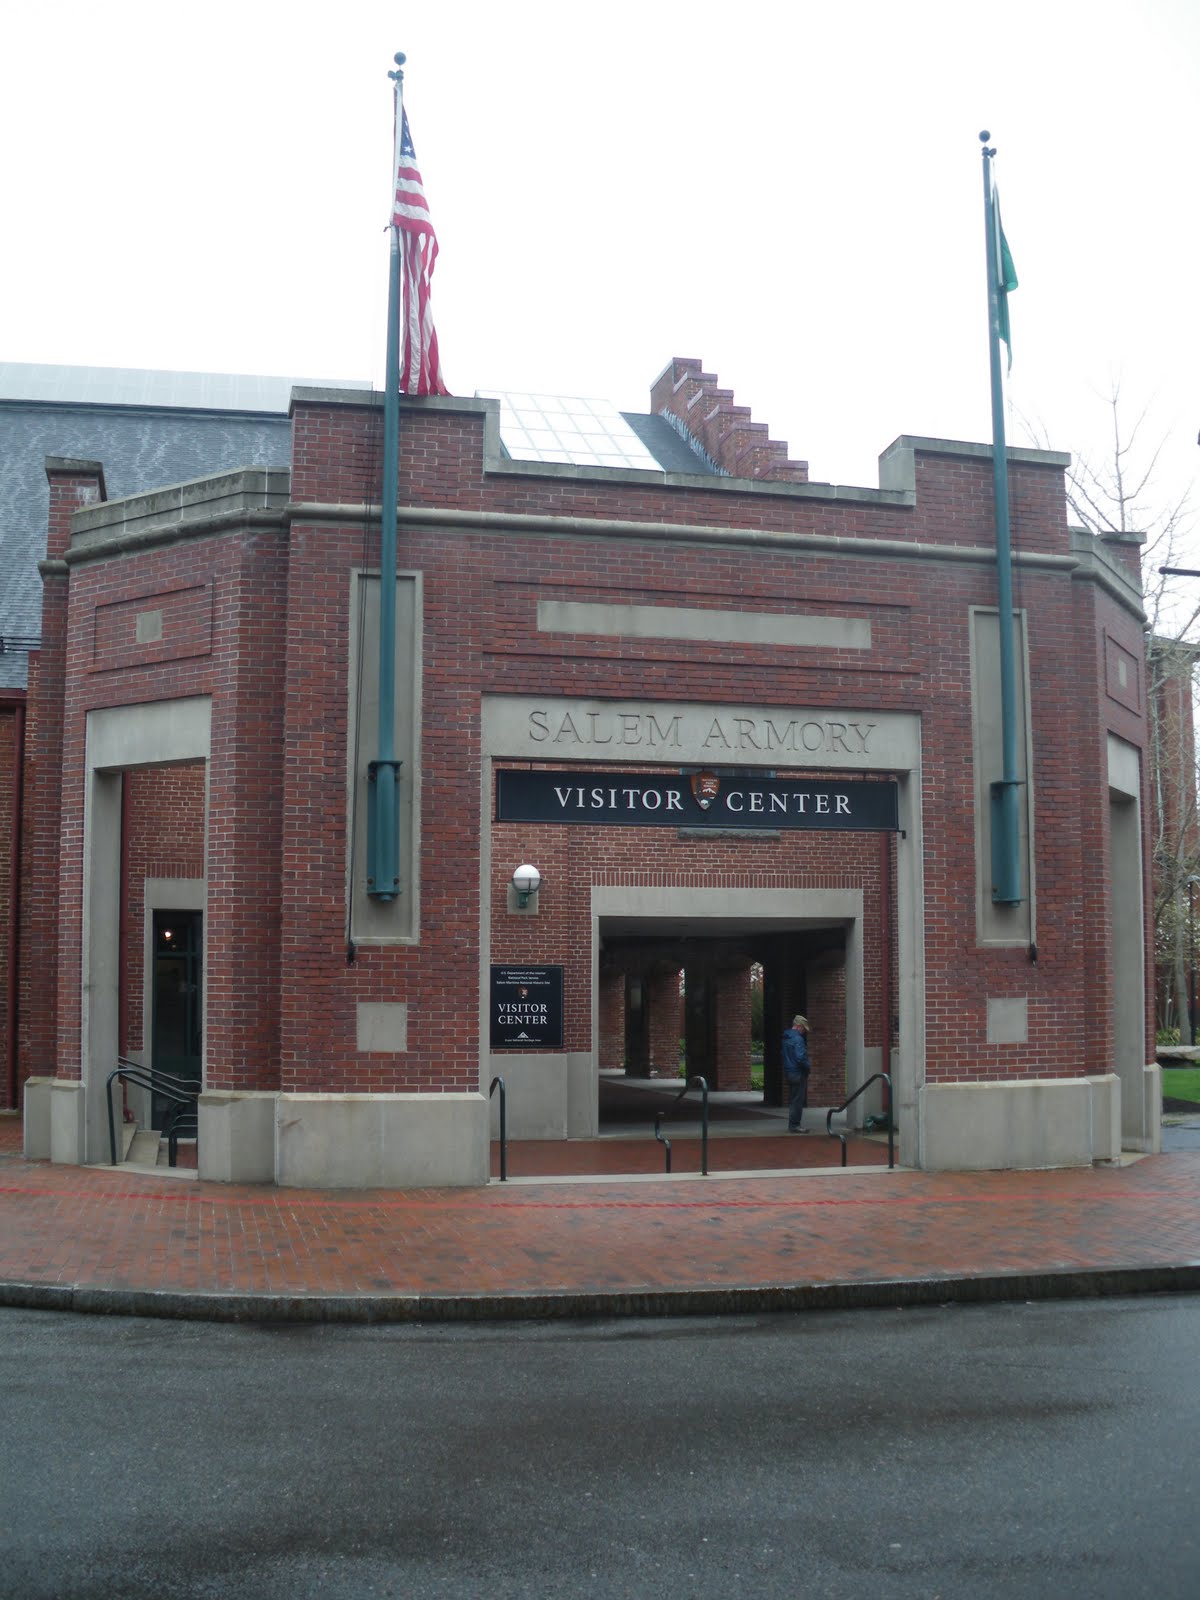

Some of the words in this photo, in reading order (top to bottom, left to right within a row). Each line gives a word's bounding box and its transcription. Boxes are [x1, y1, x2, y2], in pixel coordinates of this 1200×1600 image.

[529, 711, 683, 747] SALEM
[701, 718, 877, 753] ARMORY
[554, 787, 684, 810] VISITOR
[726, 791, 852, 814] CENTER
[498, 1003, 548, 1013] VISITOR
[498, 1015, 548, 1025] CENTER
